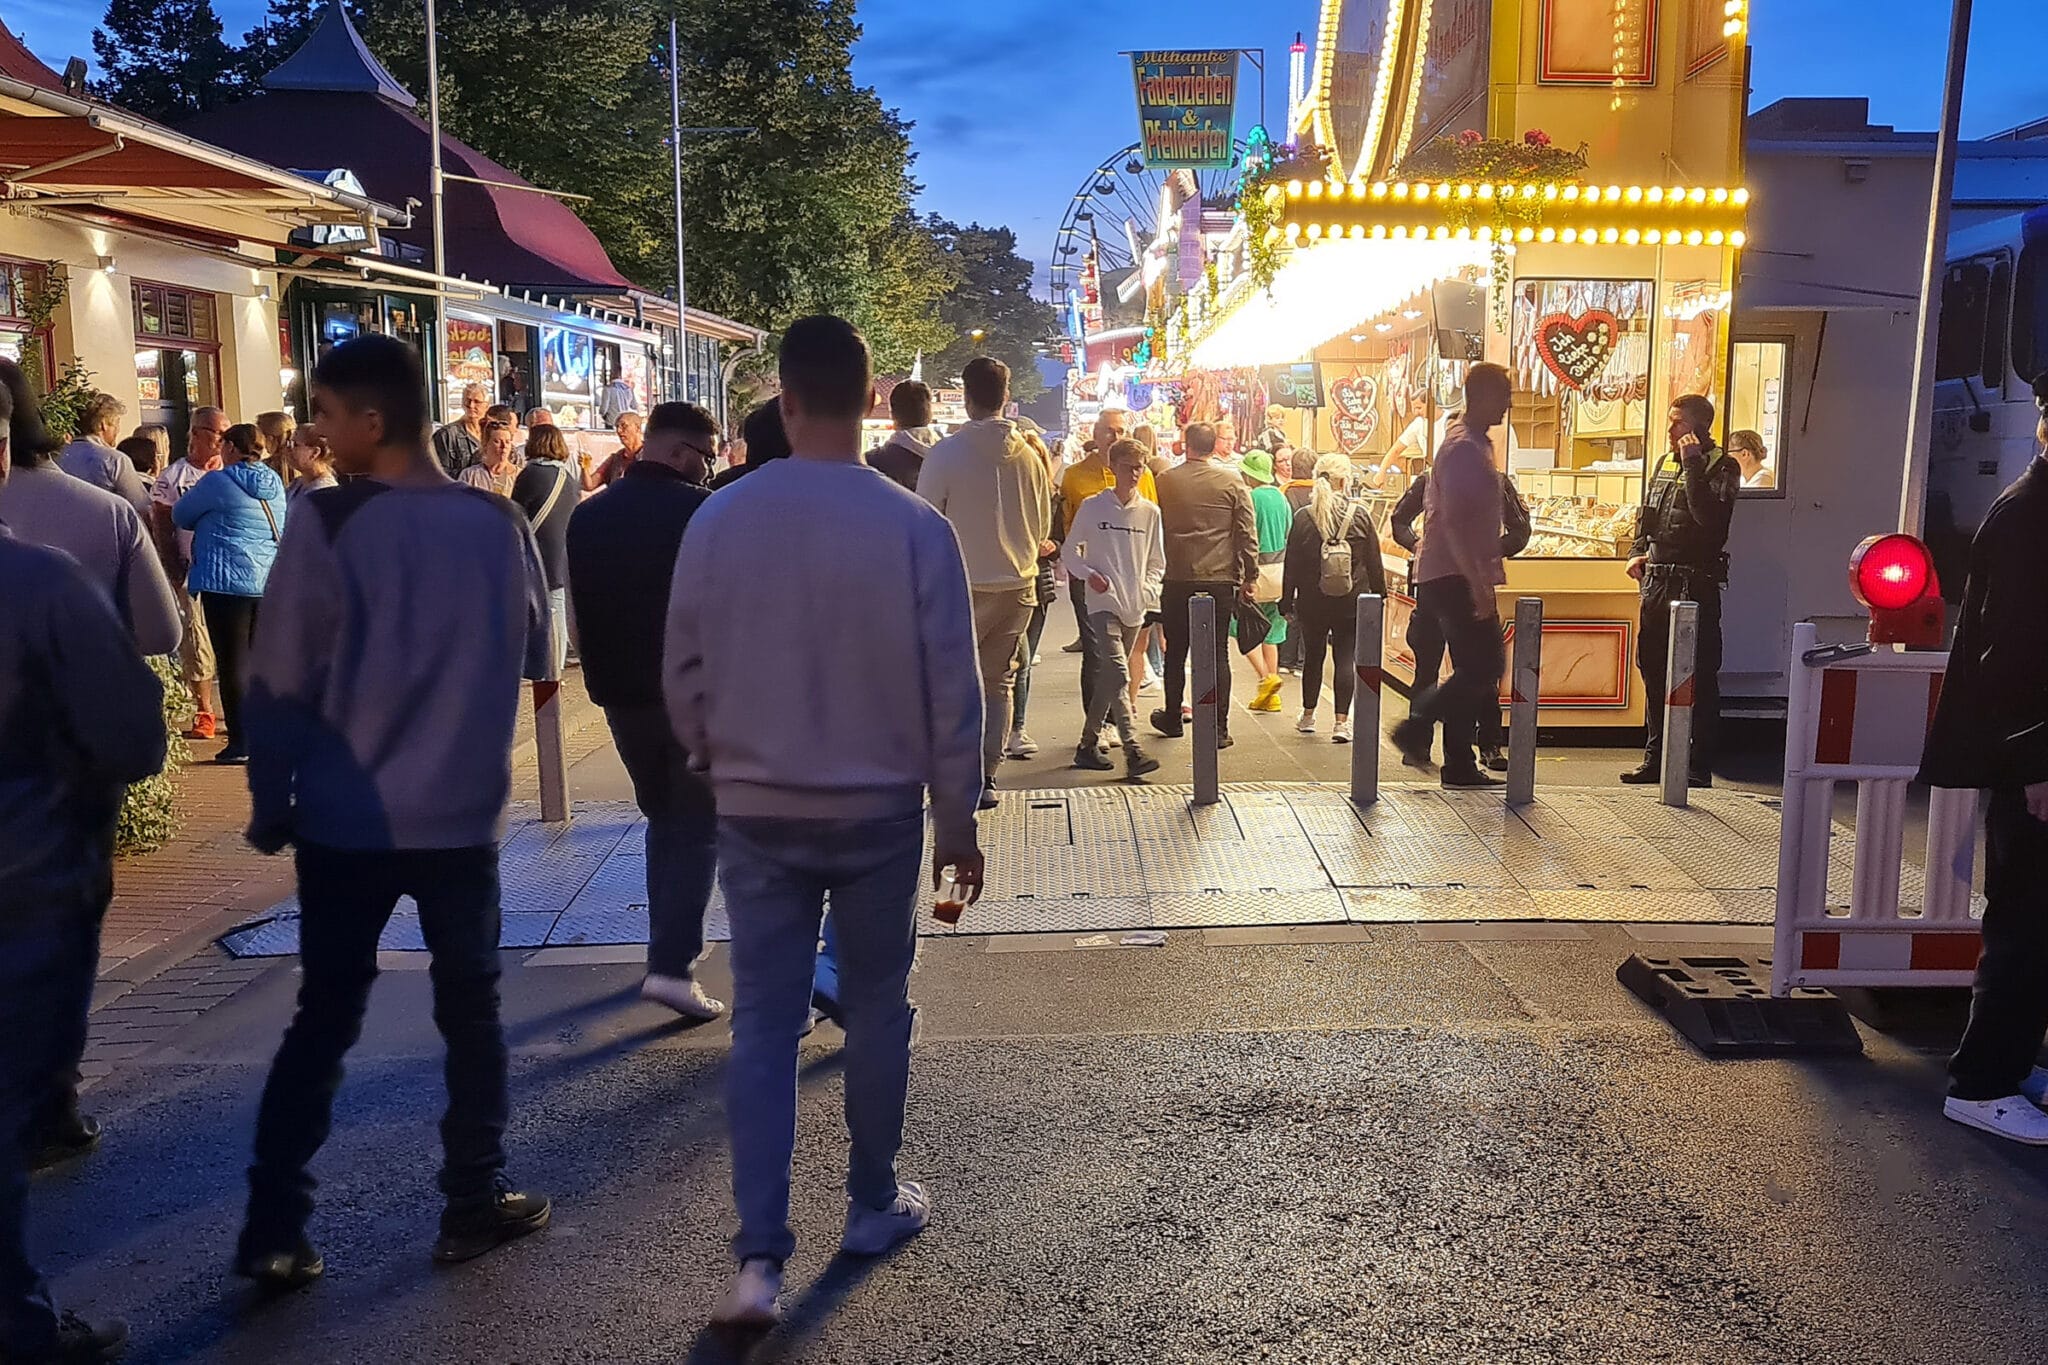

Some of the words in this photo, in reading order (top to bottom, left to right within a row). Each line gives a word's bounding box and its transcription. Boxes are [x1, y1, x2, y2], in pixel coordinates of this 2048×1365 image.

[1136, 66, 1232, 106] Fadenziehen
[1181, 109, 1200, 126] &
[1144, 119, 1228, 160] Pfeilwerfen
[1549, 332, 1576, 351] Ich
[1569, 354, 1598, 377] Dich
